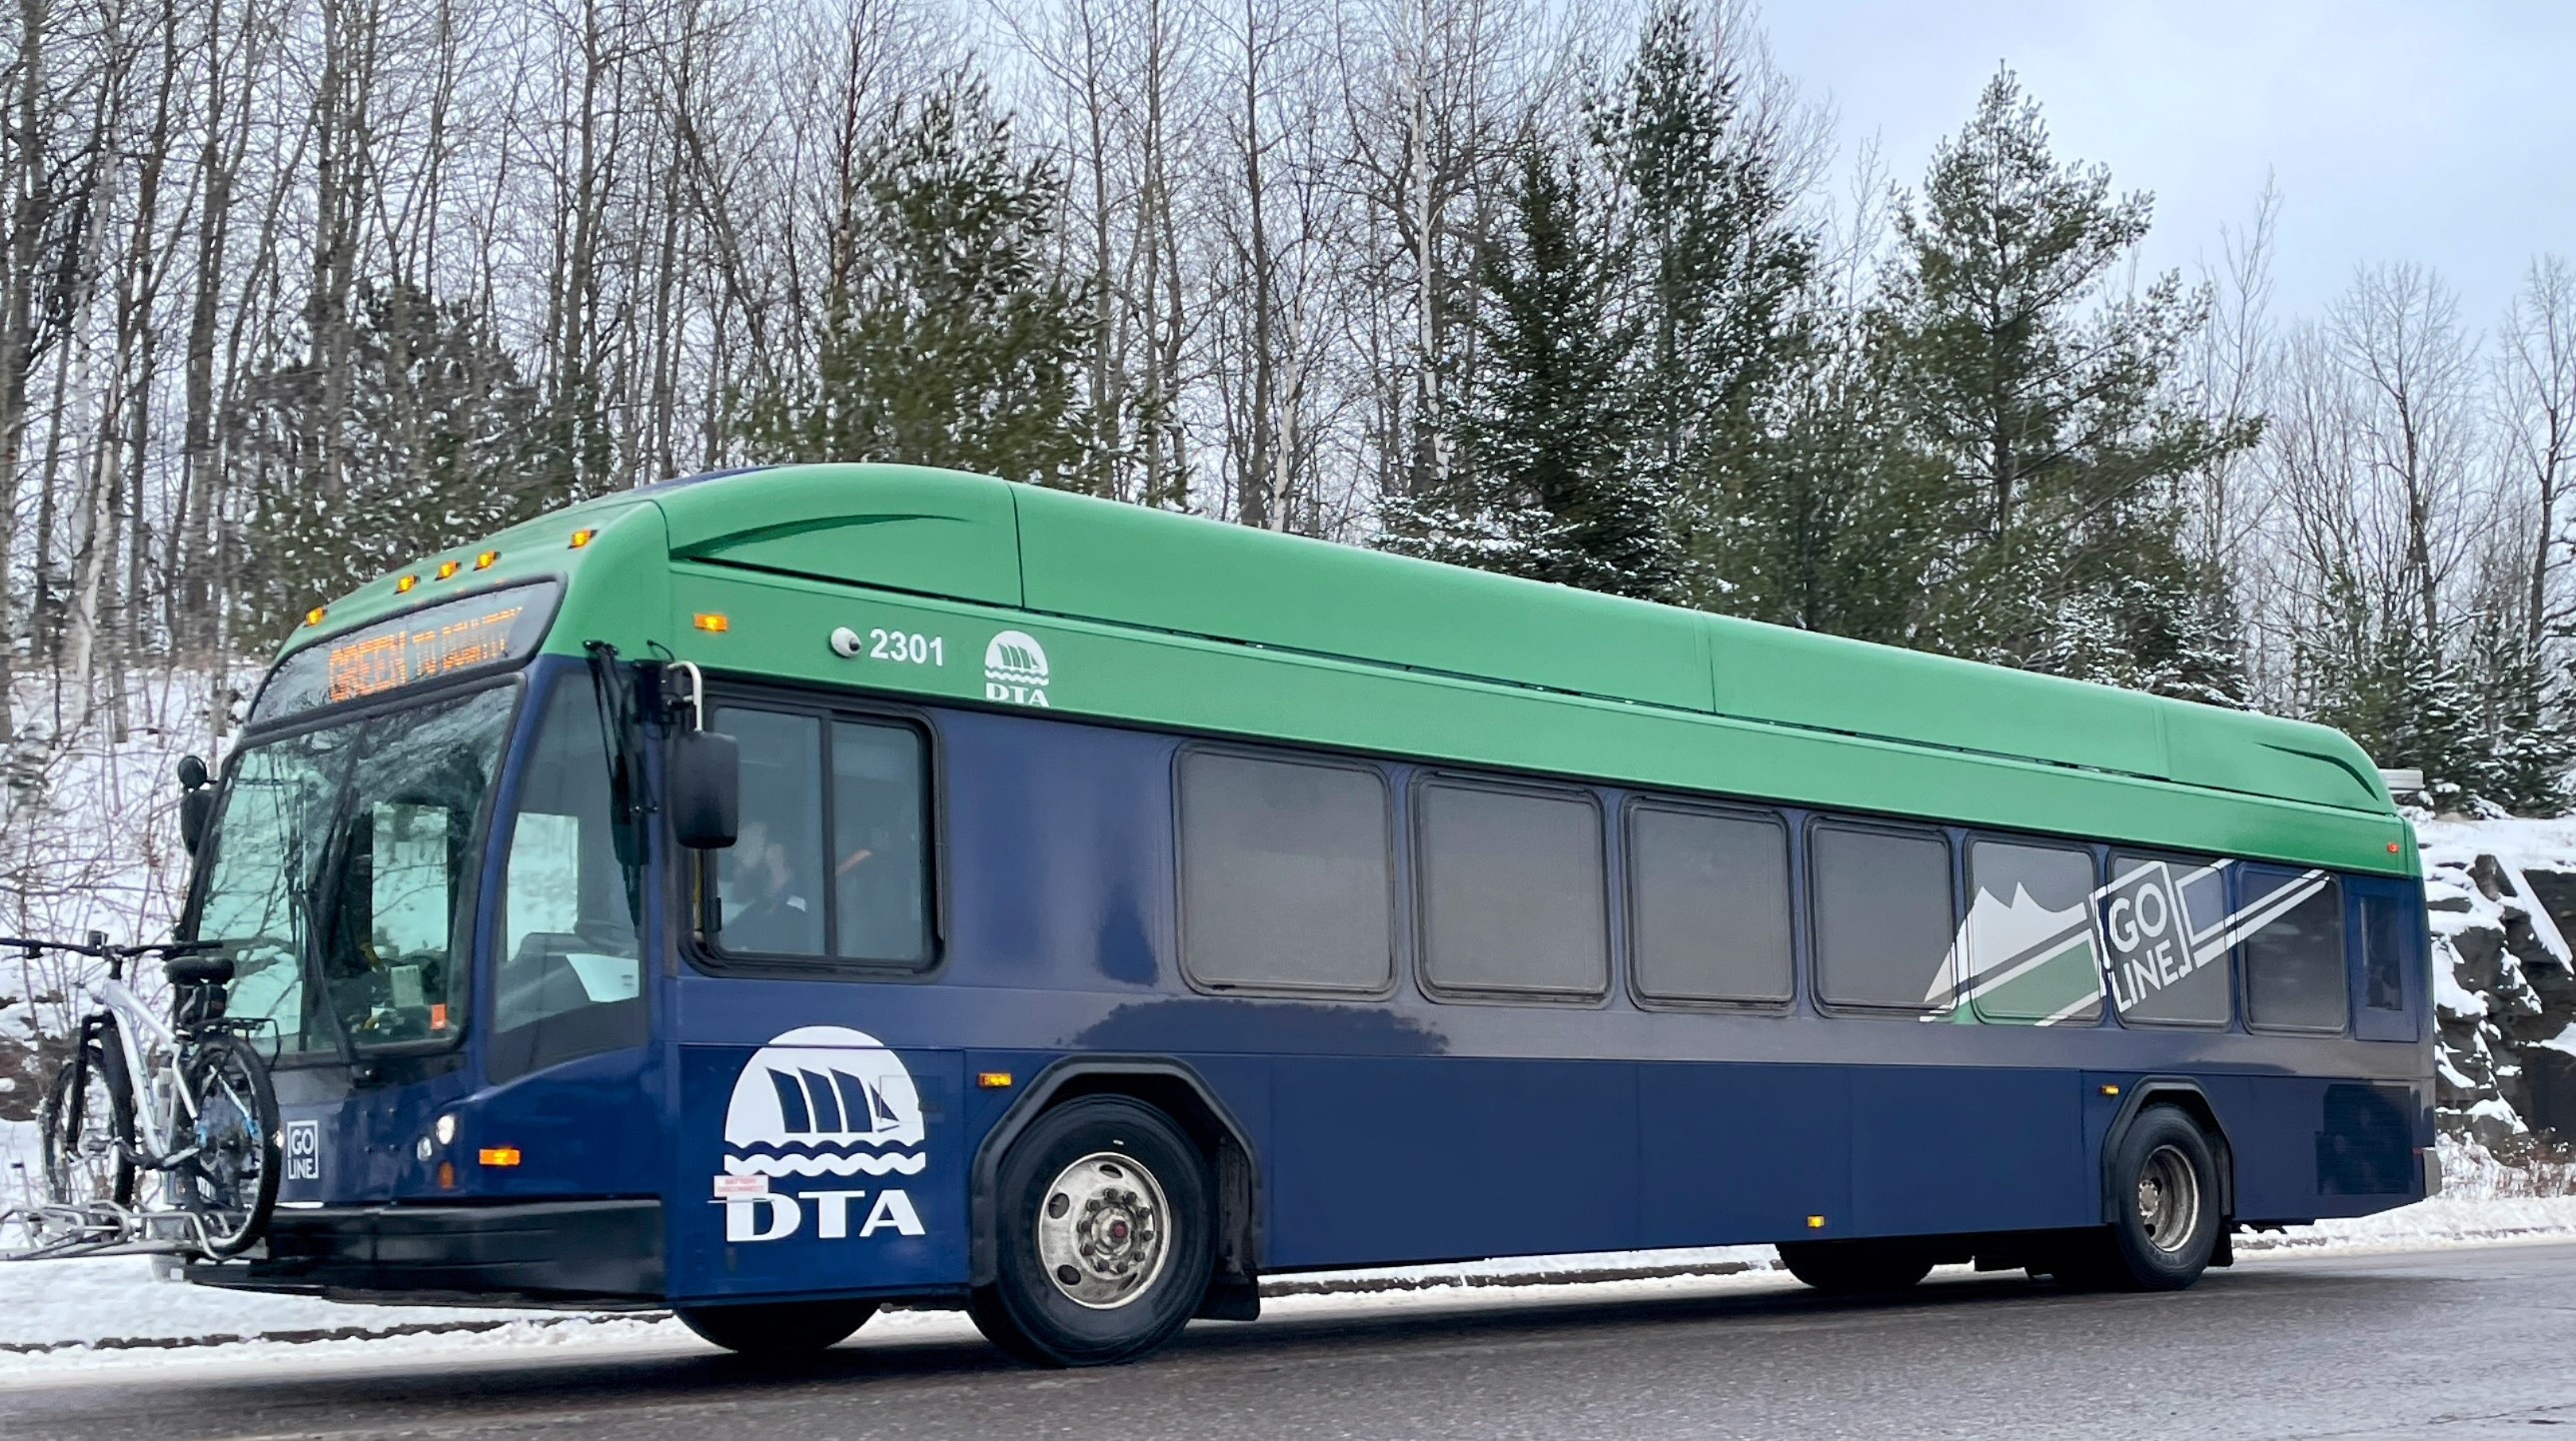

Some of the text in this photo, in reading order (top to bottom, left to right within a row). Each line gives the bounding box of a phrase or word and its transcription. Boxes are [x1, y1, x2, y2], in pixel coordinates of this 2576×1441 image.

[869, 628, 943, 667] 2301
[985, 682, 1050, 709] DTA
[2108, 882, 2167, 953] GO
[2107, 938, 2179, 1013] LINE
[291, 1127, 315, 1155] GO
[288, 1157, 314, 1179] LINE
[725, 1189, 926, 1242] DTA
